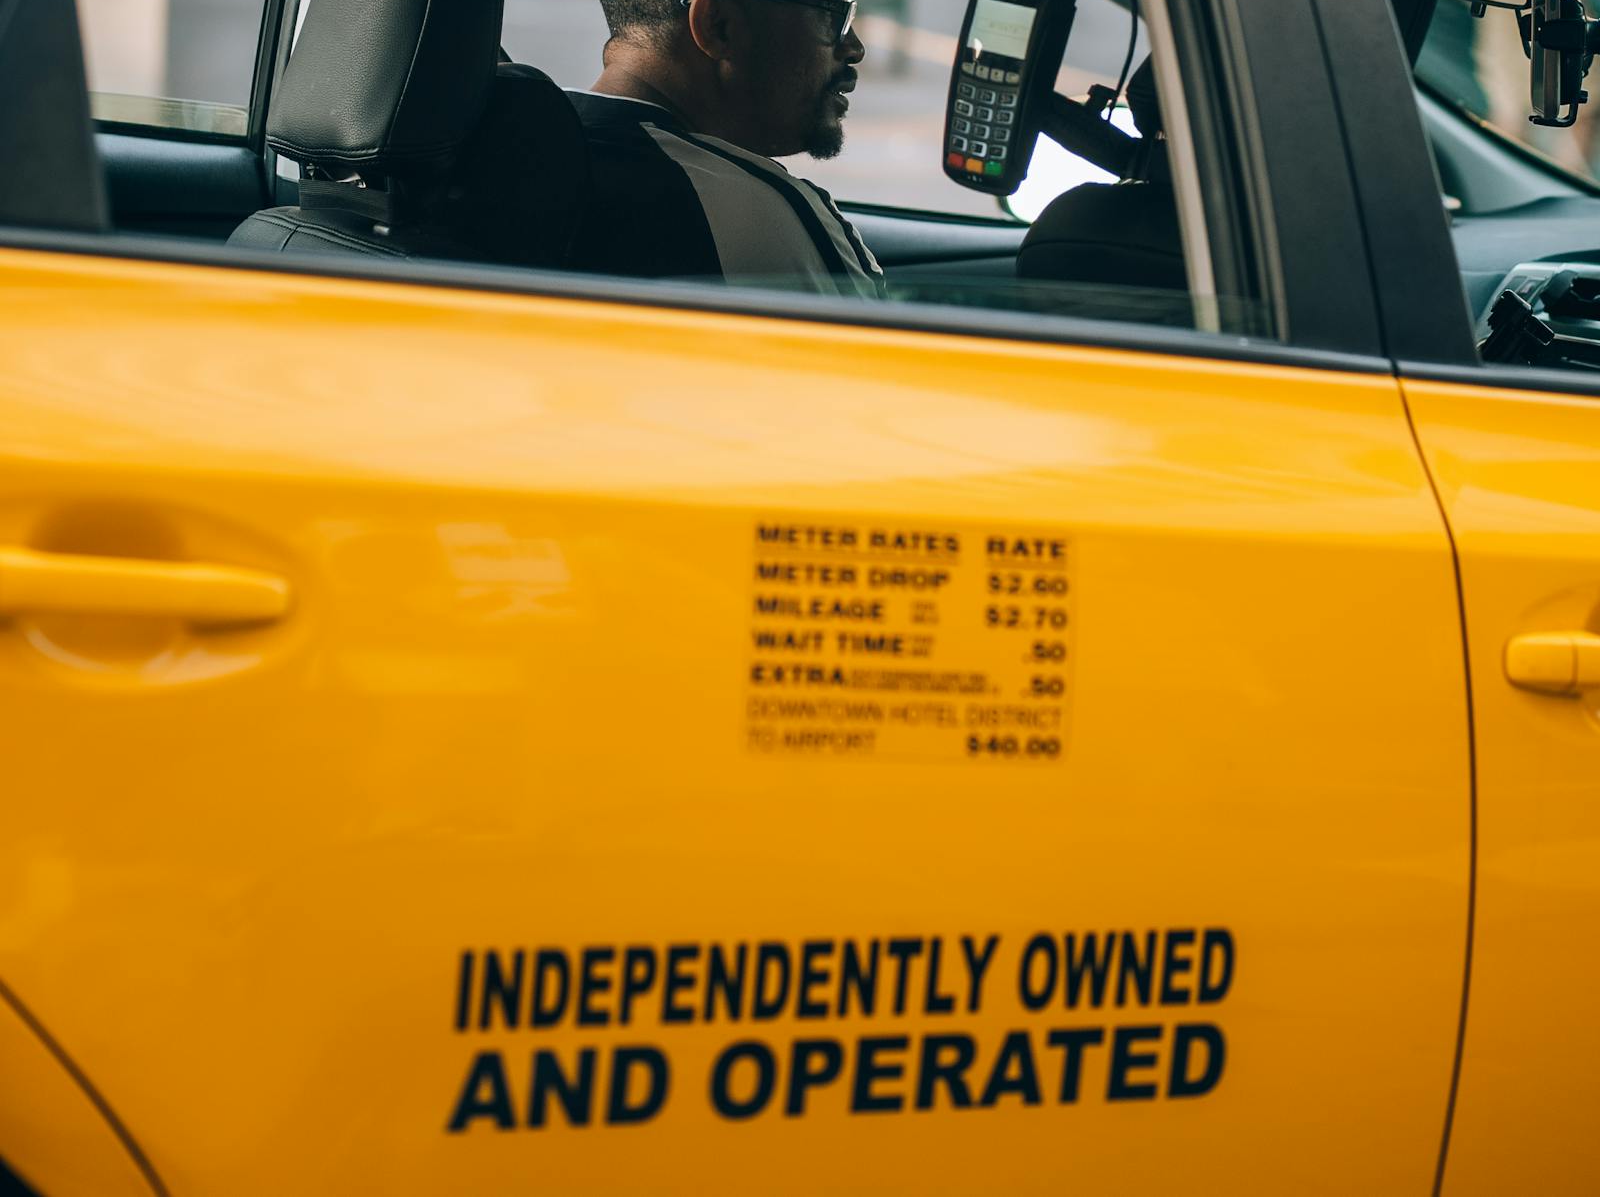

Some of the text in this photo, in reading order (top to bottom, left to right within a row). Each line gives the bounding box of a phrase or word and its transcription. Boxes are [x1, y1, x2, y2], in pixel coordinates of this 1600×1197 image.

[755, 525, 1068, 559] METER RATES RATE
[754, 563, 858, 585] METER
[868, 568, 950, 591] DROP
[753, 596, 885, 621] MILEAGE
[985, 605, 1068, 629] $2.70
[751, 630, 825, 652] WAIT
[837, 632, 904, 654] TIME
[750, 665, 845, 686] EXTRA
[748, 697, 1062, 729] DOWNTOWN HOTEL DISTRICT
[748, 728, 1061, 757] TO AIRPORT $40.00
[454, 927, 1237, 1033] INDEPENDENTLY OWNED
[446, 1021, 1227, 1133] AND OPERATED
